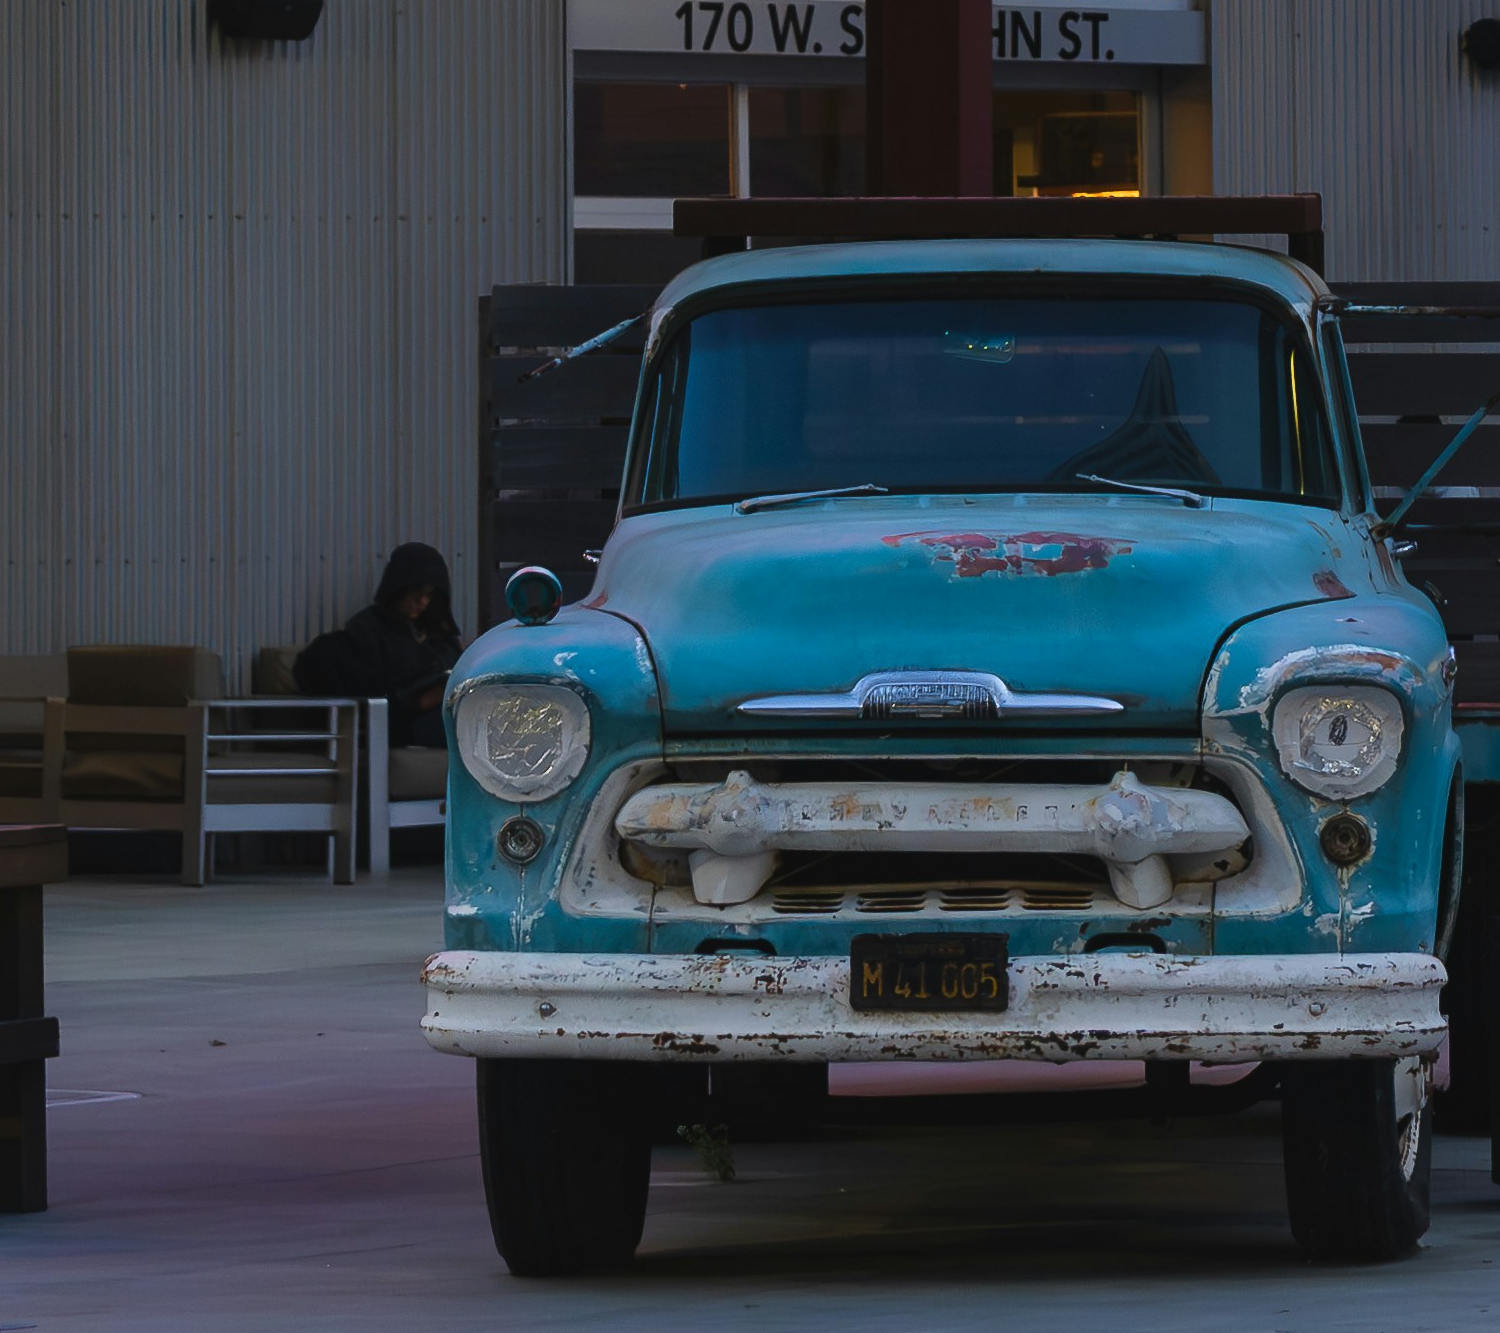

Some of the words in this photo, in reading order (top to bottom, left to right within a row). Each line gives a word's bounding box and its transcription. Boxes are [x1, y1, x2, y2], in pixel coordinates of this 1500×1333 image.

[675, 1, 754, 53] 170
[768, 2, 823, 54] W.
[1058, 10, 1116, 61] ST.
